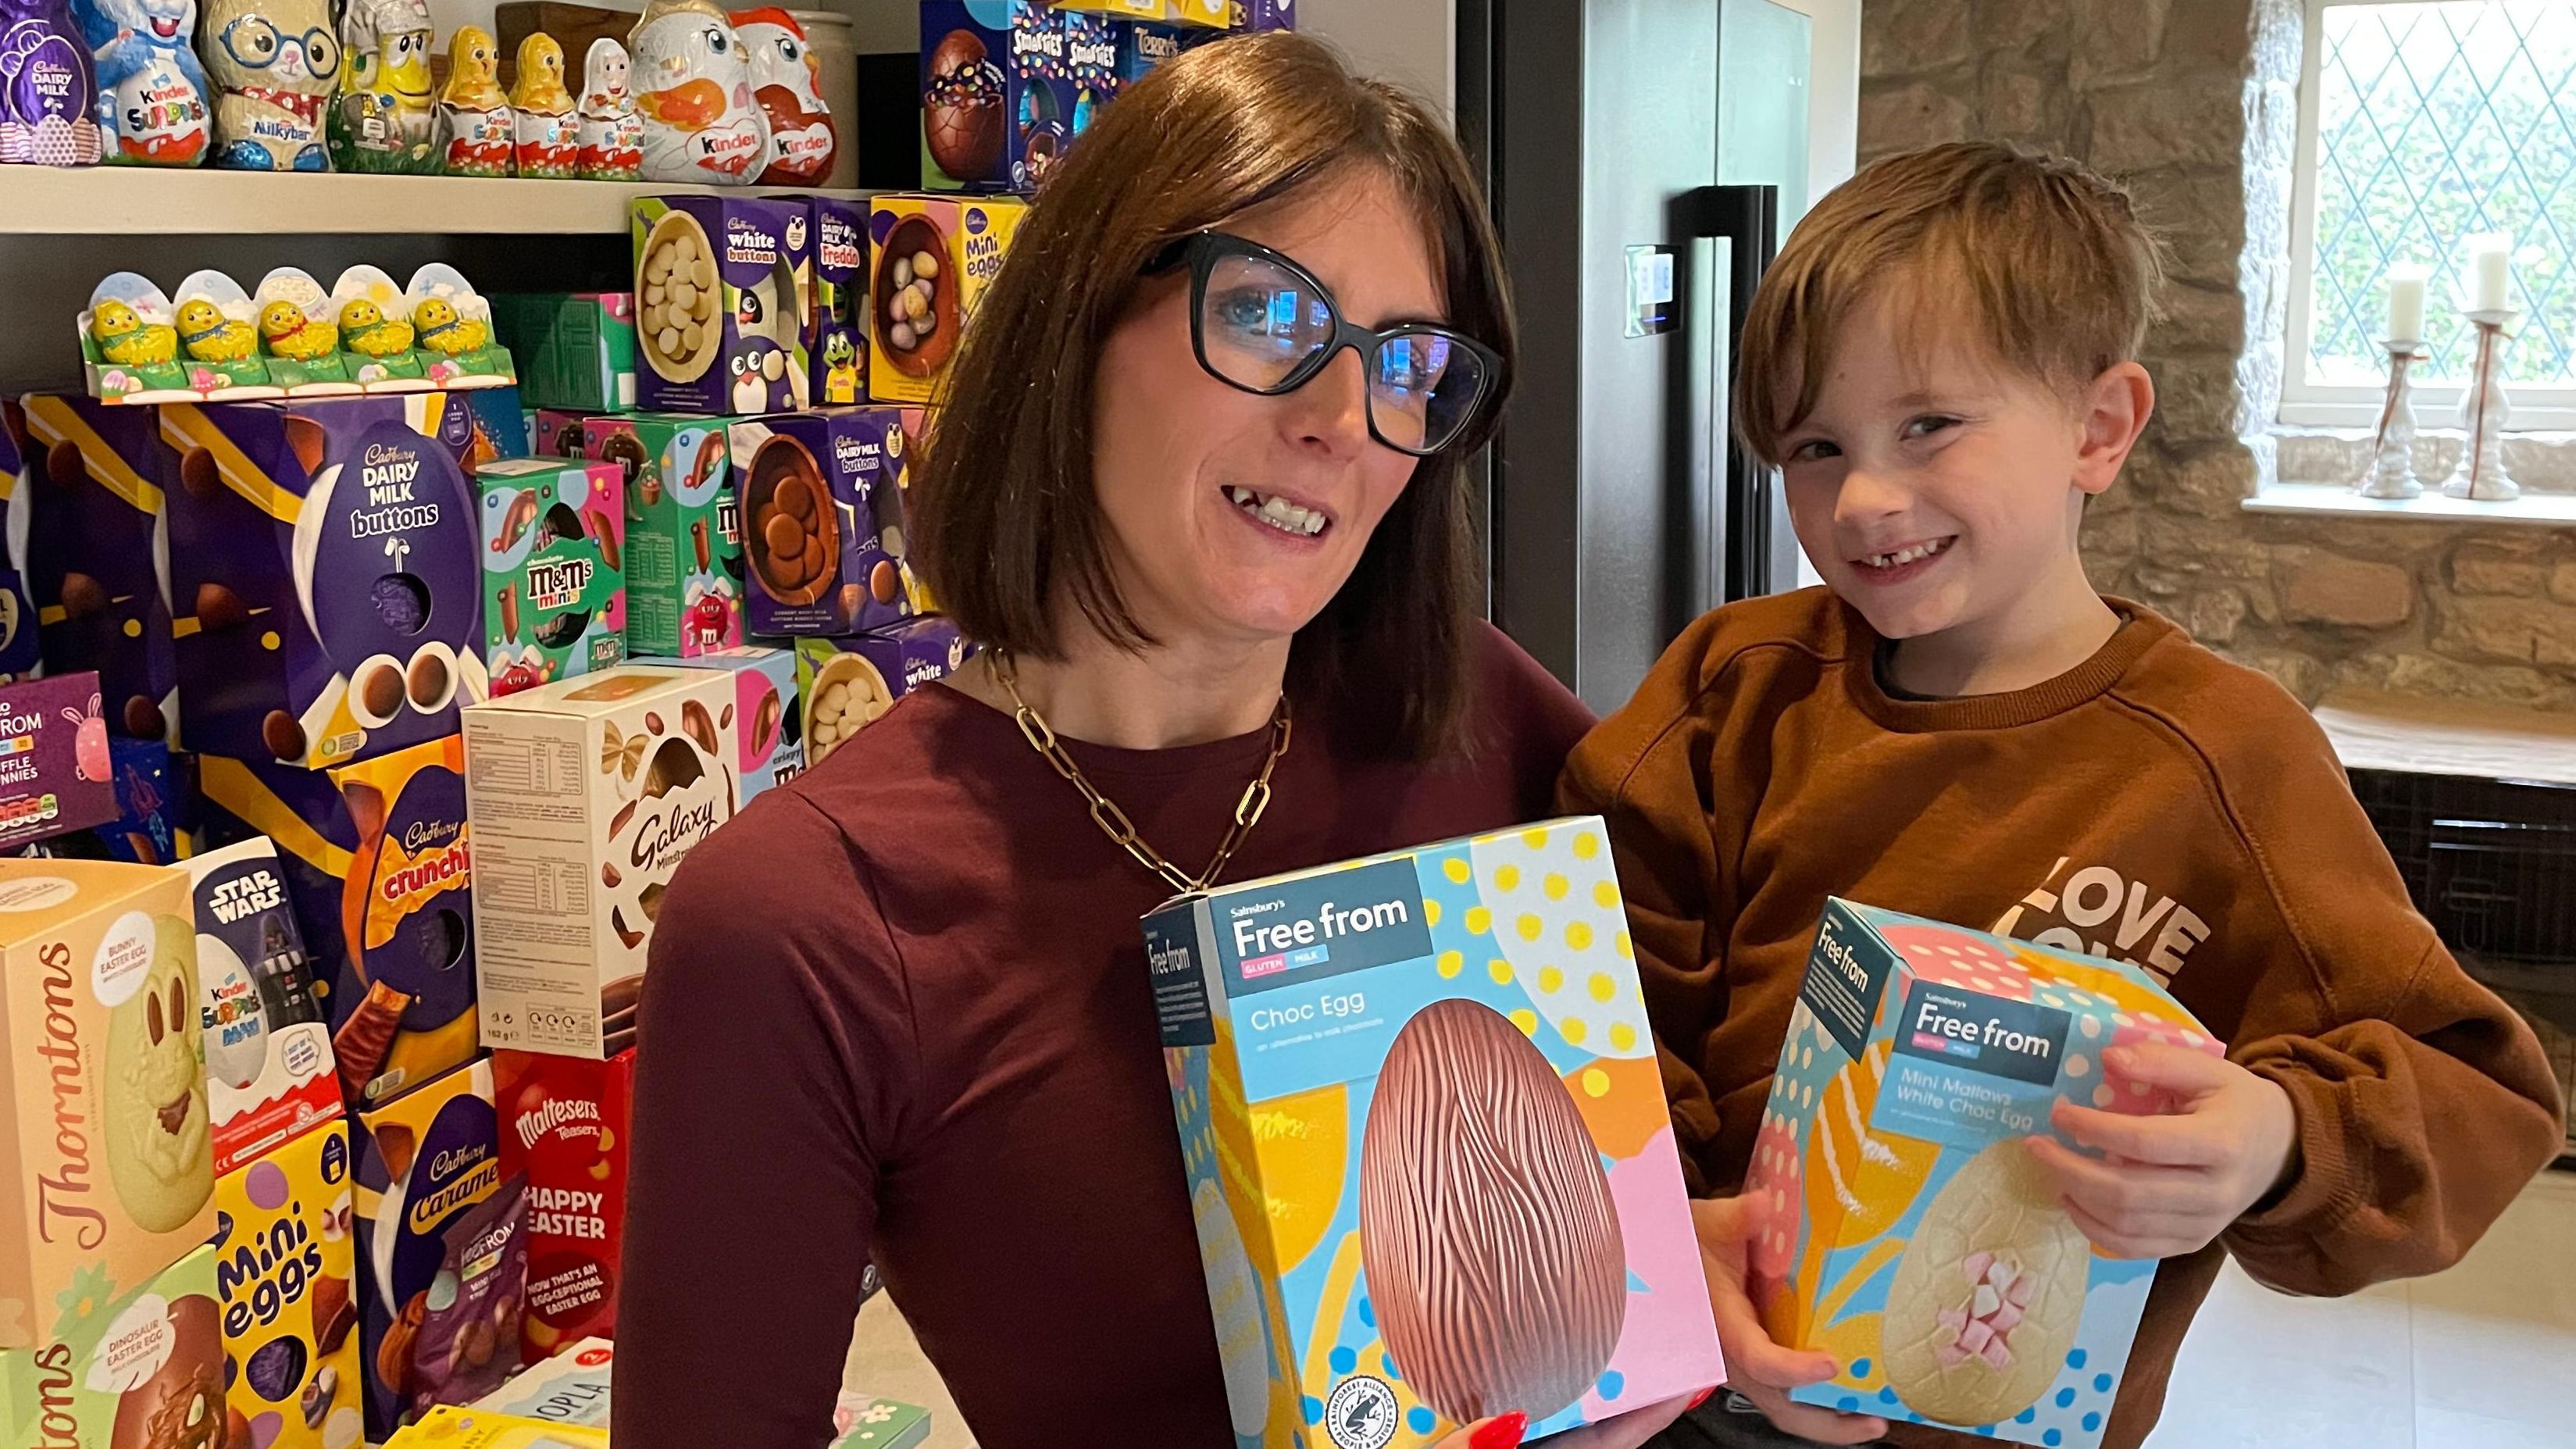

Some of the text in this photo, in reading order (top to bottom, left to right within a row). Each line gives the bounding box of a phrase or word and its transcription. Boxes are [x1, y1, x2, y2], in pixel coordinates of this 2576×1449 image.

[31, 73, 72, 85] DAIRY
[37, 84, 69, 96] MILK
[254, 121, 310, 141] Milkybar
[701, 134, 755, 154] Kinder
[777, 136, 826, 155] Kinder
[728, 230, 775, 248] white
[822, 224, 844, 234] DAIRY
[822, 234, 840, 244] MILK
[728, 248, 776, 263] buttons
[822, 246, 858, 265] Freddo
[966, 231, 997, 259] Mini
[365, 444, 415, 466] Cadbury
[837, 443, 880, 459] DAIRY MILK
[362, 461, 419, 487] DAIRY
[843, 458, 879, 473] buttons
[370, 483, 414, 506] MILK
[351, 505, 438, 537] buttons
[540, 590, 578, 608] minis
[905, 665, 941, 687] white
[1, 713, 42, 736] ROM
[1, 756, 31, 773] FFLE
[772, 748, 801, 765] crispy
[1, 768, 38, 786] NNIES
[406, 819, 458, 849] Cadbury
[631, 800, 718, 871] Galaxy
[384, 840, 469, 899] crunchi
[657, 847, 689, 870] Minstr
[209, 870, 278, 908] STAR
[212, 886, 280, 925] WARS
[1230, 899, 1286, 918] Sainsbury's
[1233, 900, 1408, 957] Free from
[101, 953, 129, 974] EASTER
[131, 944, 146, 959] EGG
[109, 937, 137, 958] BUNNY
[1818, 921, 1843, 965] Free
[1840, 945, 1868, 994] from
[1244, 951, 1319, 975] GLUTEN MILK
[1251, 992, 1365, 1030] Choc Egg
[1916, 1002, 1978, 1041] Free
[1983, 1019, 2050, 1058] from
[37, 942, 107, 1251] Thorntons
[1901, 1068, 2013, 1105] Mini Mallows
[1897, 1085, 1944, 1109] White
[1949, 1098, 1996, 1120] Choc
[2000, 1105, 2034, 1130] Egg
[516, 1097, 599, 1150] Maltesers
[555, 1126, 600, 1140] Teasers
[430, 1144, 486, 1181] Cadbury
[416, 1163, 498, 1222] Carame
[527, 1187, 602, 1214] HAPPY
[218, 1201, 307, 1303] Mini
[224, 1243, 322, 1338] eggs
[527, 1263, 598, 1295] NOW THAT'S AN
[546, 1289, 601, 1315] EASTER EGG
[108, 1341, 142, 1366] EASTER
[144, 1329, 162, 1346] EGG
[109, 1319, 159, 1352] DINOSAUR
[528, 1383, 611, 1421] OPLA
[1332, 1382, 1360, 1425] RAINFOREST
[1364, 1382, 1393, 1409] ALLIANCE
